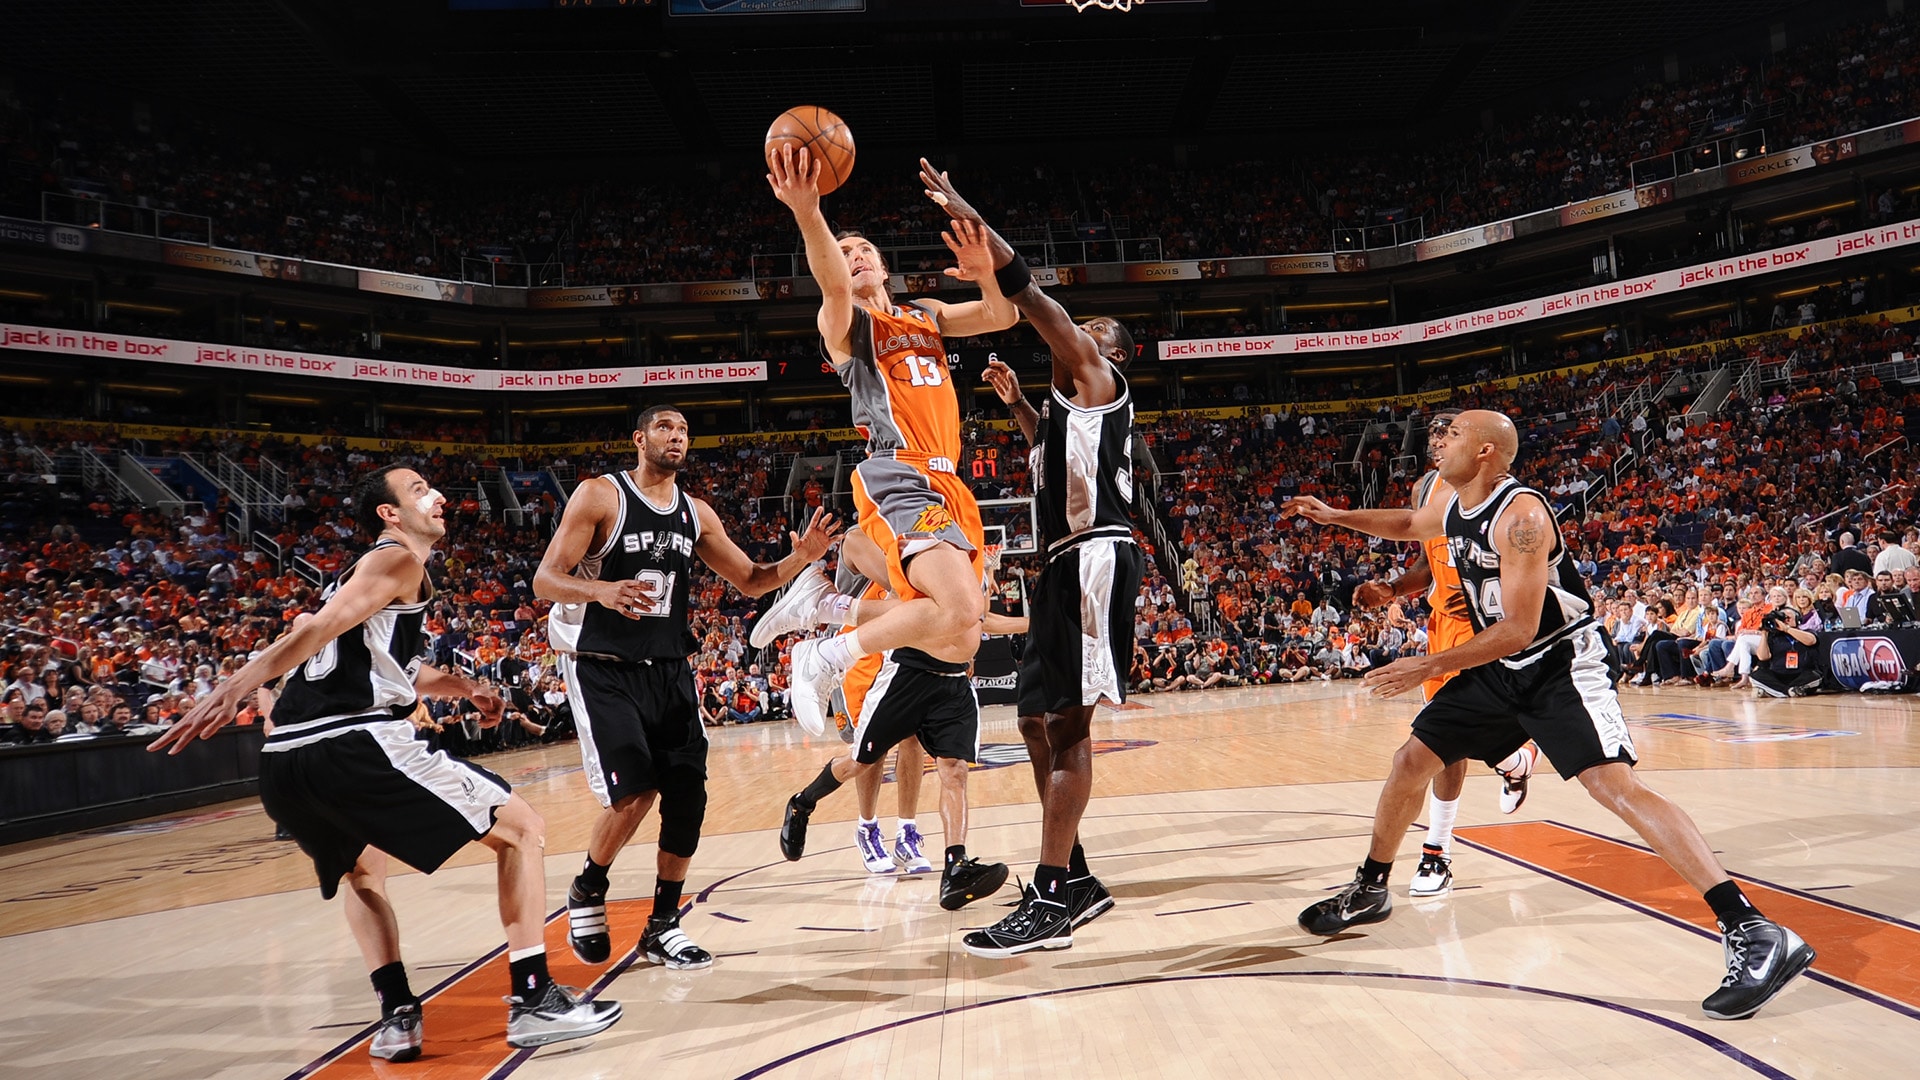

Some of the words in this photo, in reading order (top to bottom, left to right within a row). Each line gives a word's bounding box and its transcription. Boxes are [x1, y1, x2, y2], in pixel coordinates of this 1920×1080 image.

[1841, 142, 1852, 154] 34
[1738, 155, 1801, 179] BARKLEY
[1661, 188, 1667, 198] 9
[1570, 199, 1627, 219] MAJERLE
[1506, 227, 1512, 236] 7
[56, 232, 80, 245] 1993
[1834, 233, 1875, 256] jack
[1880, 230, 1898, 243] in
[1424, 236, 1475, 255] JOHNSON
[169, 248, 252, 269] WESTPHAL
[1271, 260, 1329, 270] CHAMBERS
[1356, 258, 1365, 268] 24
[286, 265, 297, 275] 44
[1146, 267, 1179, 276] DAVIS
[1220, 264, 1226, 273] 6
[1679, 266, 1714, 287] jack
[1719, 263, 1734, 276] in
[1739, 257, 1767, 272] the
[1773, 251, 1806, 266] box
[380, 279, 424, 292] PROSKI
[927, 277, 937, 288] 33
[633, 291, 639, 300] 5
[693, 287, 749, 297] HAWKINS
[780, 285, 789, 295] 42
[555, 293, 605, 302] ARSDALE
[1541, 295, 1572, 315] jack
[1576, 292, 1590, 306] in
[1594, 286, 1619, 301] the
[1623, 281, 1653, 296] box
[1422, 321, 1452, 339] jack
[1455, 318, 1468, 330] in
[1471, 312, 1494, 327] the
[1498, 307, 1524, 321] box
[1, 328, 50, 346] jack
[56, 332, 76, 348] in
[82, 335, 118, 352] the
[124, 340, 163, 356] box
[1294, 336, 1324, 350] jack
[1328, 335, 1340, 346] in
[1343, 333, 1368, 345] the
[1372, 331, 1399, 343] box
[1135, 344, 1144, 357] 7
[1166, 342, 1196, 358] jack
[1200, 341, 1213, 353] in
[1217, 340, 1241, 352] the
[1245, 339, 1270, 351] box
[195, 346, 236, 363] jack
[242, 350, 258, 365] in
[264, 353, 294, 368] the
[300, 357, 333, 371] box
[352, 361, 388, 377] jack
[393, 364, 406, 379] in
[412, 366, 437, 381] the
[443, 369, 472, 384] box
[642, 367, 676, 384] jack
[680, 367, 694, 379] in
[697, 366, 724, 379] the
[728, 365, 758, 377] box
[778, 362, 787, 375] 7
[904, 355, 942, 387] 13
[498, 373, 534, 388] jack
[538, 373, 553, 386] in
[557, 372, 583, 385] the
[588, 371, 619, 384] box
[1417, 390, 1450, 402] Protectio
[1300, 402, 1332, 412] LifeLock
[975, 448, 998, 460] 9:10
[971, 459, 998, 479] 07
[631, 568, 677, 618] 21
[1832, 652, 1862, 677] NBA
[1874, 660, 1896, 674] TNT
[978, 677, 1017, 688] PLAYOFFS
